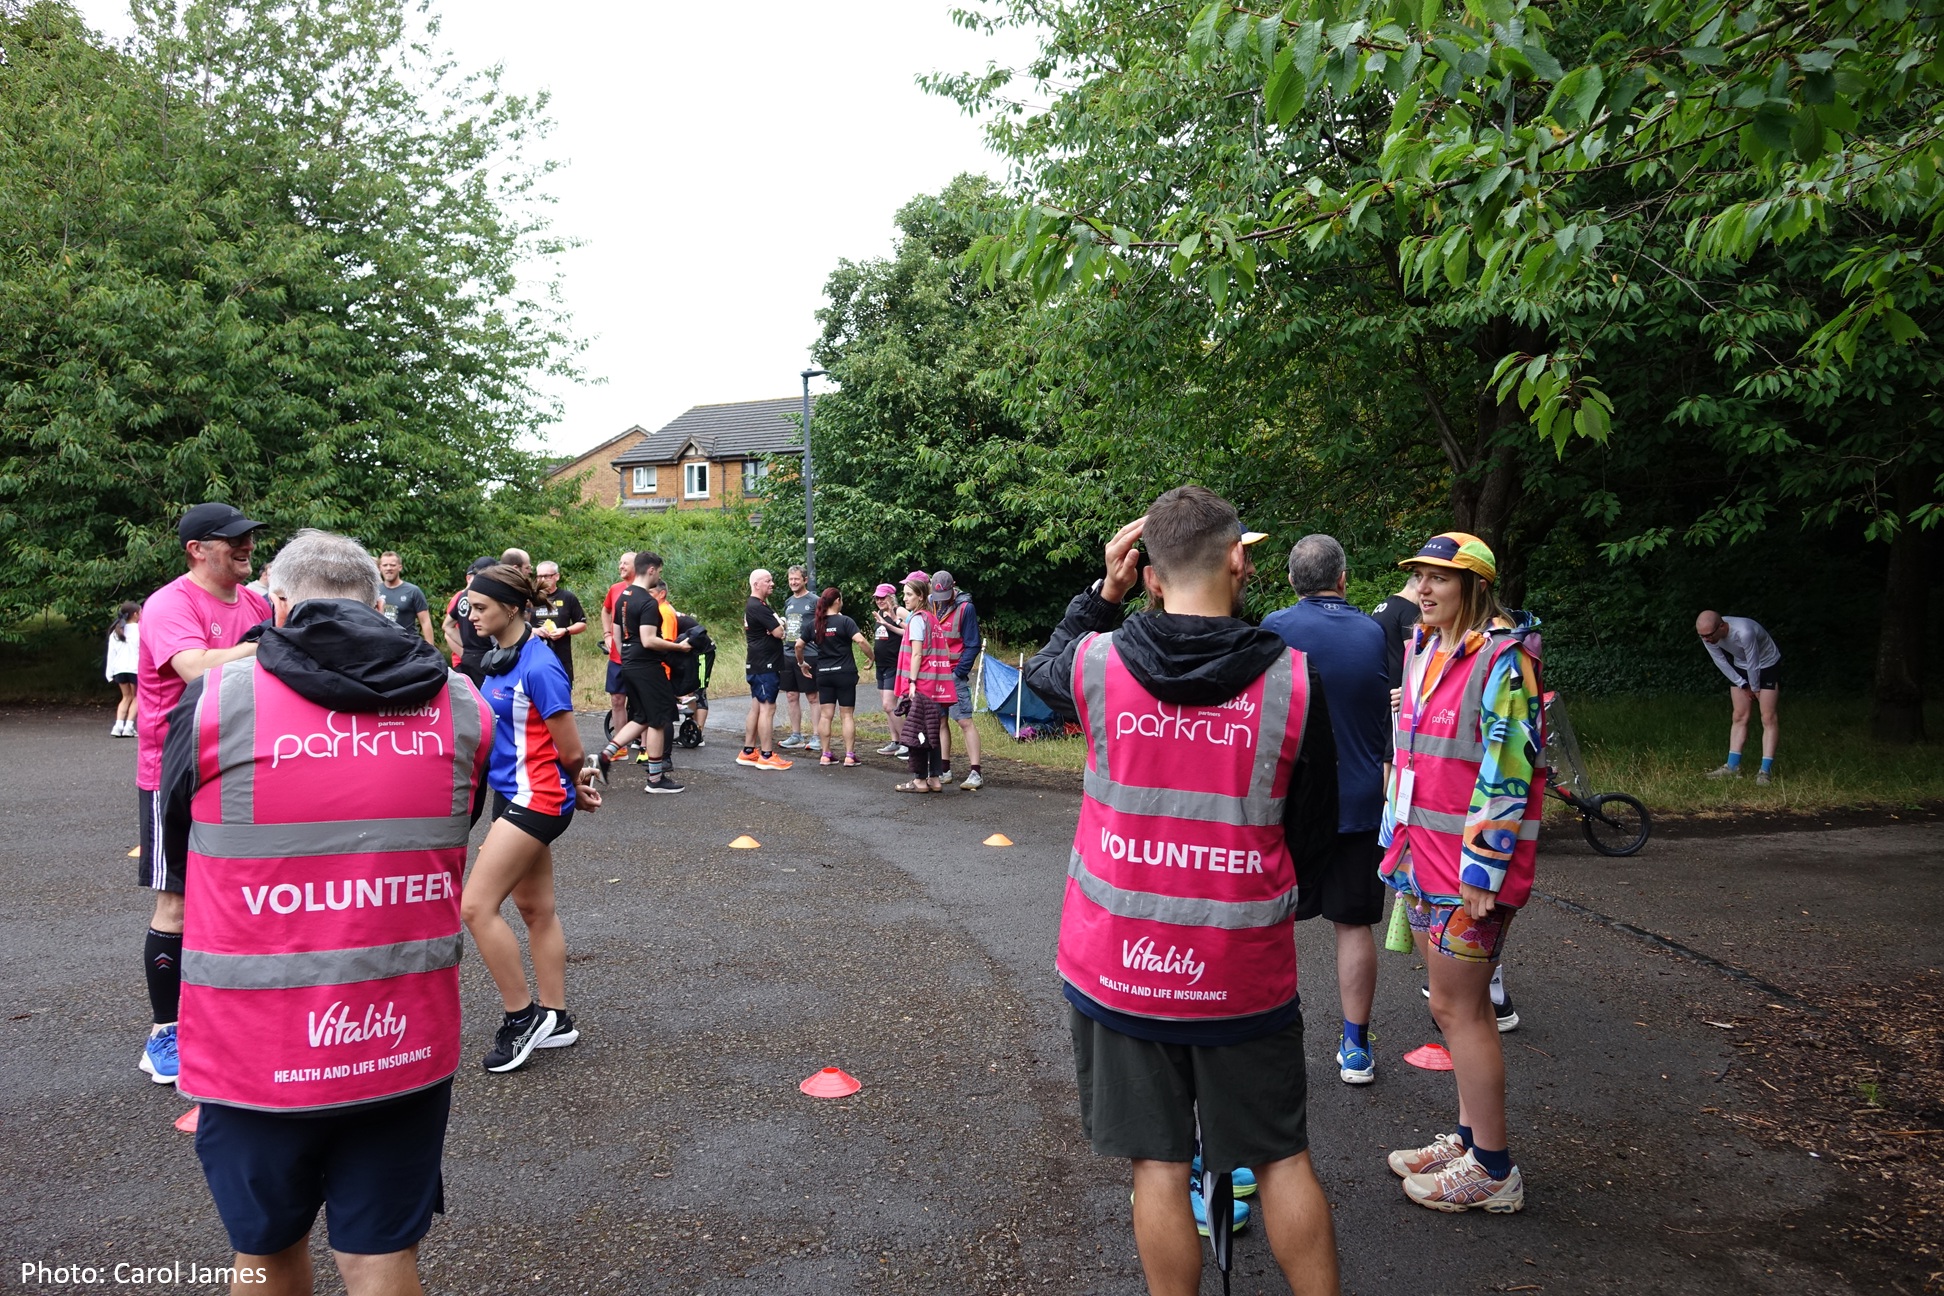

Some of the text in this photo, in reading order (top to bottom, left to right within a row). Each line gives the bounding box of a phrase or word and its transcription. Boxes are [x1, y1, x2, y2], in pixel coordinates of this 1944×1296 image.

[272, 711, 443, 768] parkrun
[1116, 700, 1252, 748] parkrun
[1101, 827, 1263, 874] VOLUNTEER
[241, 871, 454, 915] VOLUNTEER
[1122, 936, 1205, 986] Vitality
[1100, 974, 1228, 1001] HEALTH AND LIFE INSURANCE
[308, 1000, 407, 1050] Vitality
[274, 1046, 432, 1083] HEALTH AND LIFE INSURANCE
